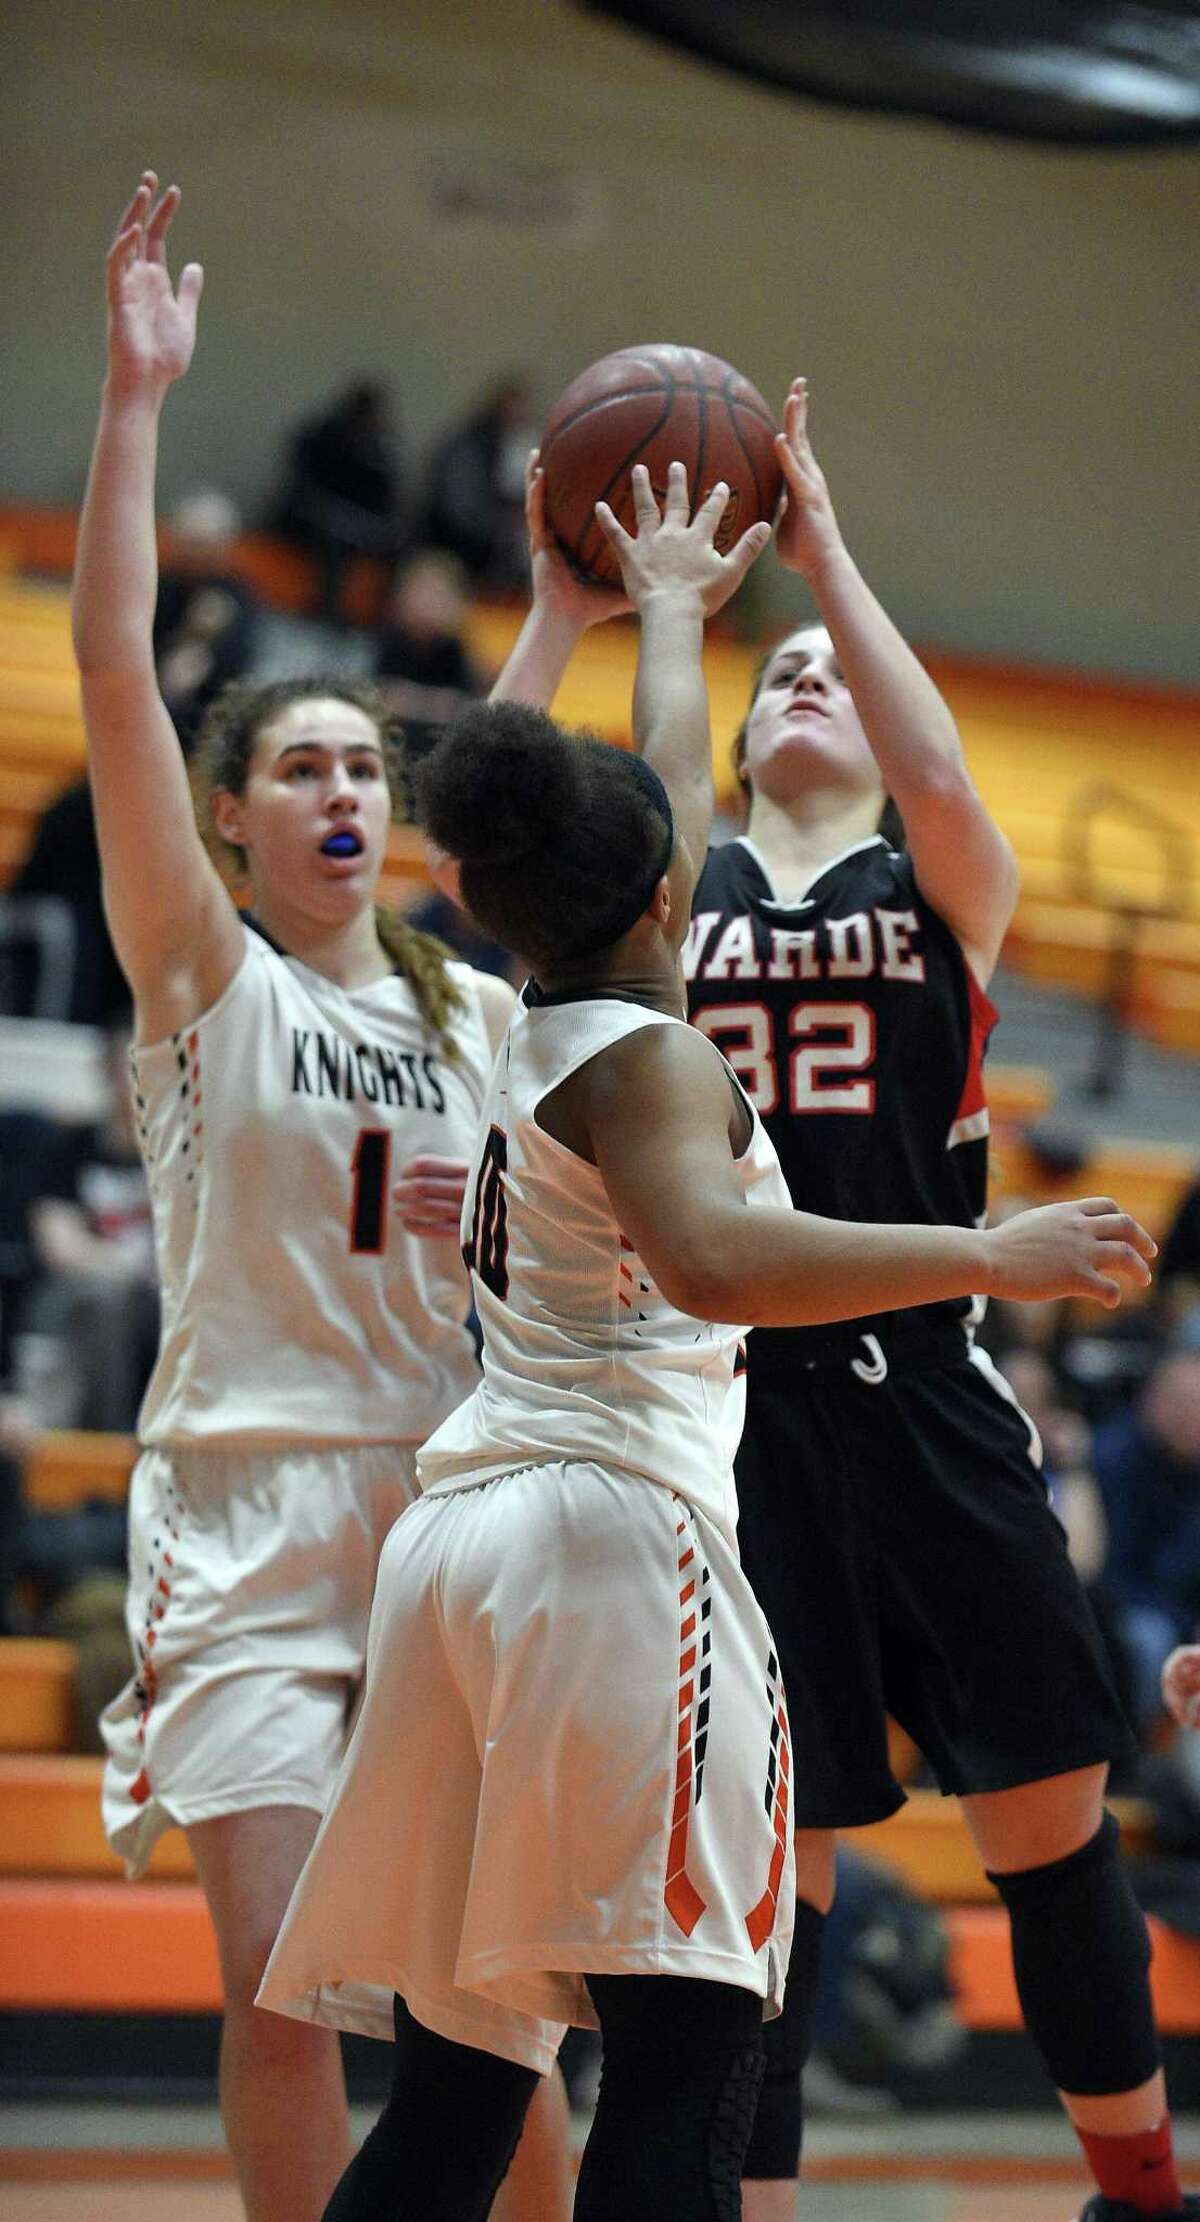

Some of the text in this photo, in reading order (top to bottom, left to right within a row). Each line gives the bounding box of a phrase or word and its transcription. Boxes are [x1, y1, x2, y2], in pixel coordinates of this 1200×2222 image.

[292, 1028, 446, 1114] KNIGHTS
[690, 1000, 877, 1116] 32
[350, 1127, 391, 1256] 1
